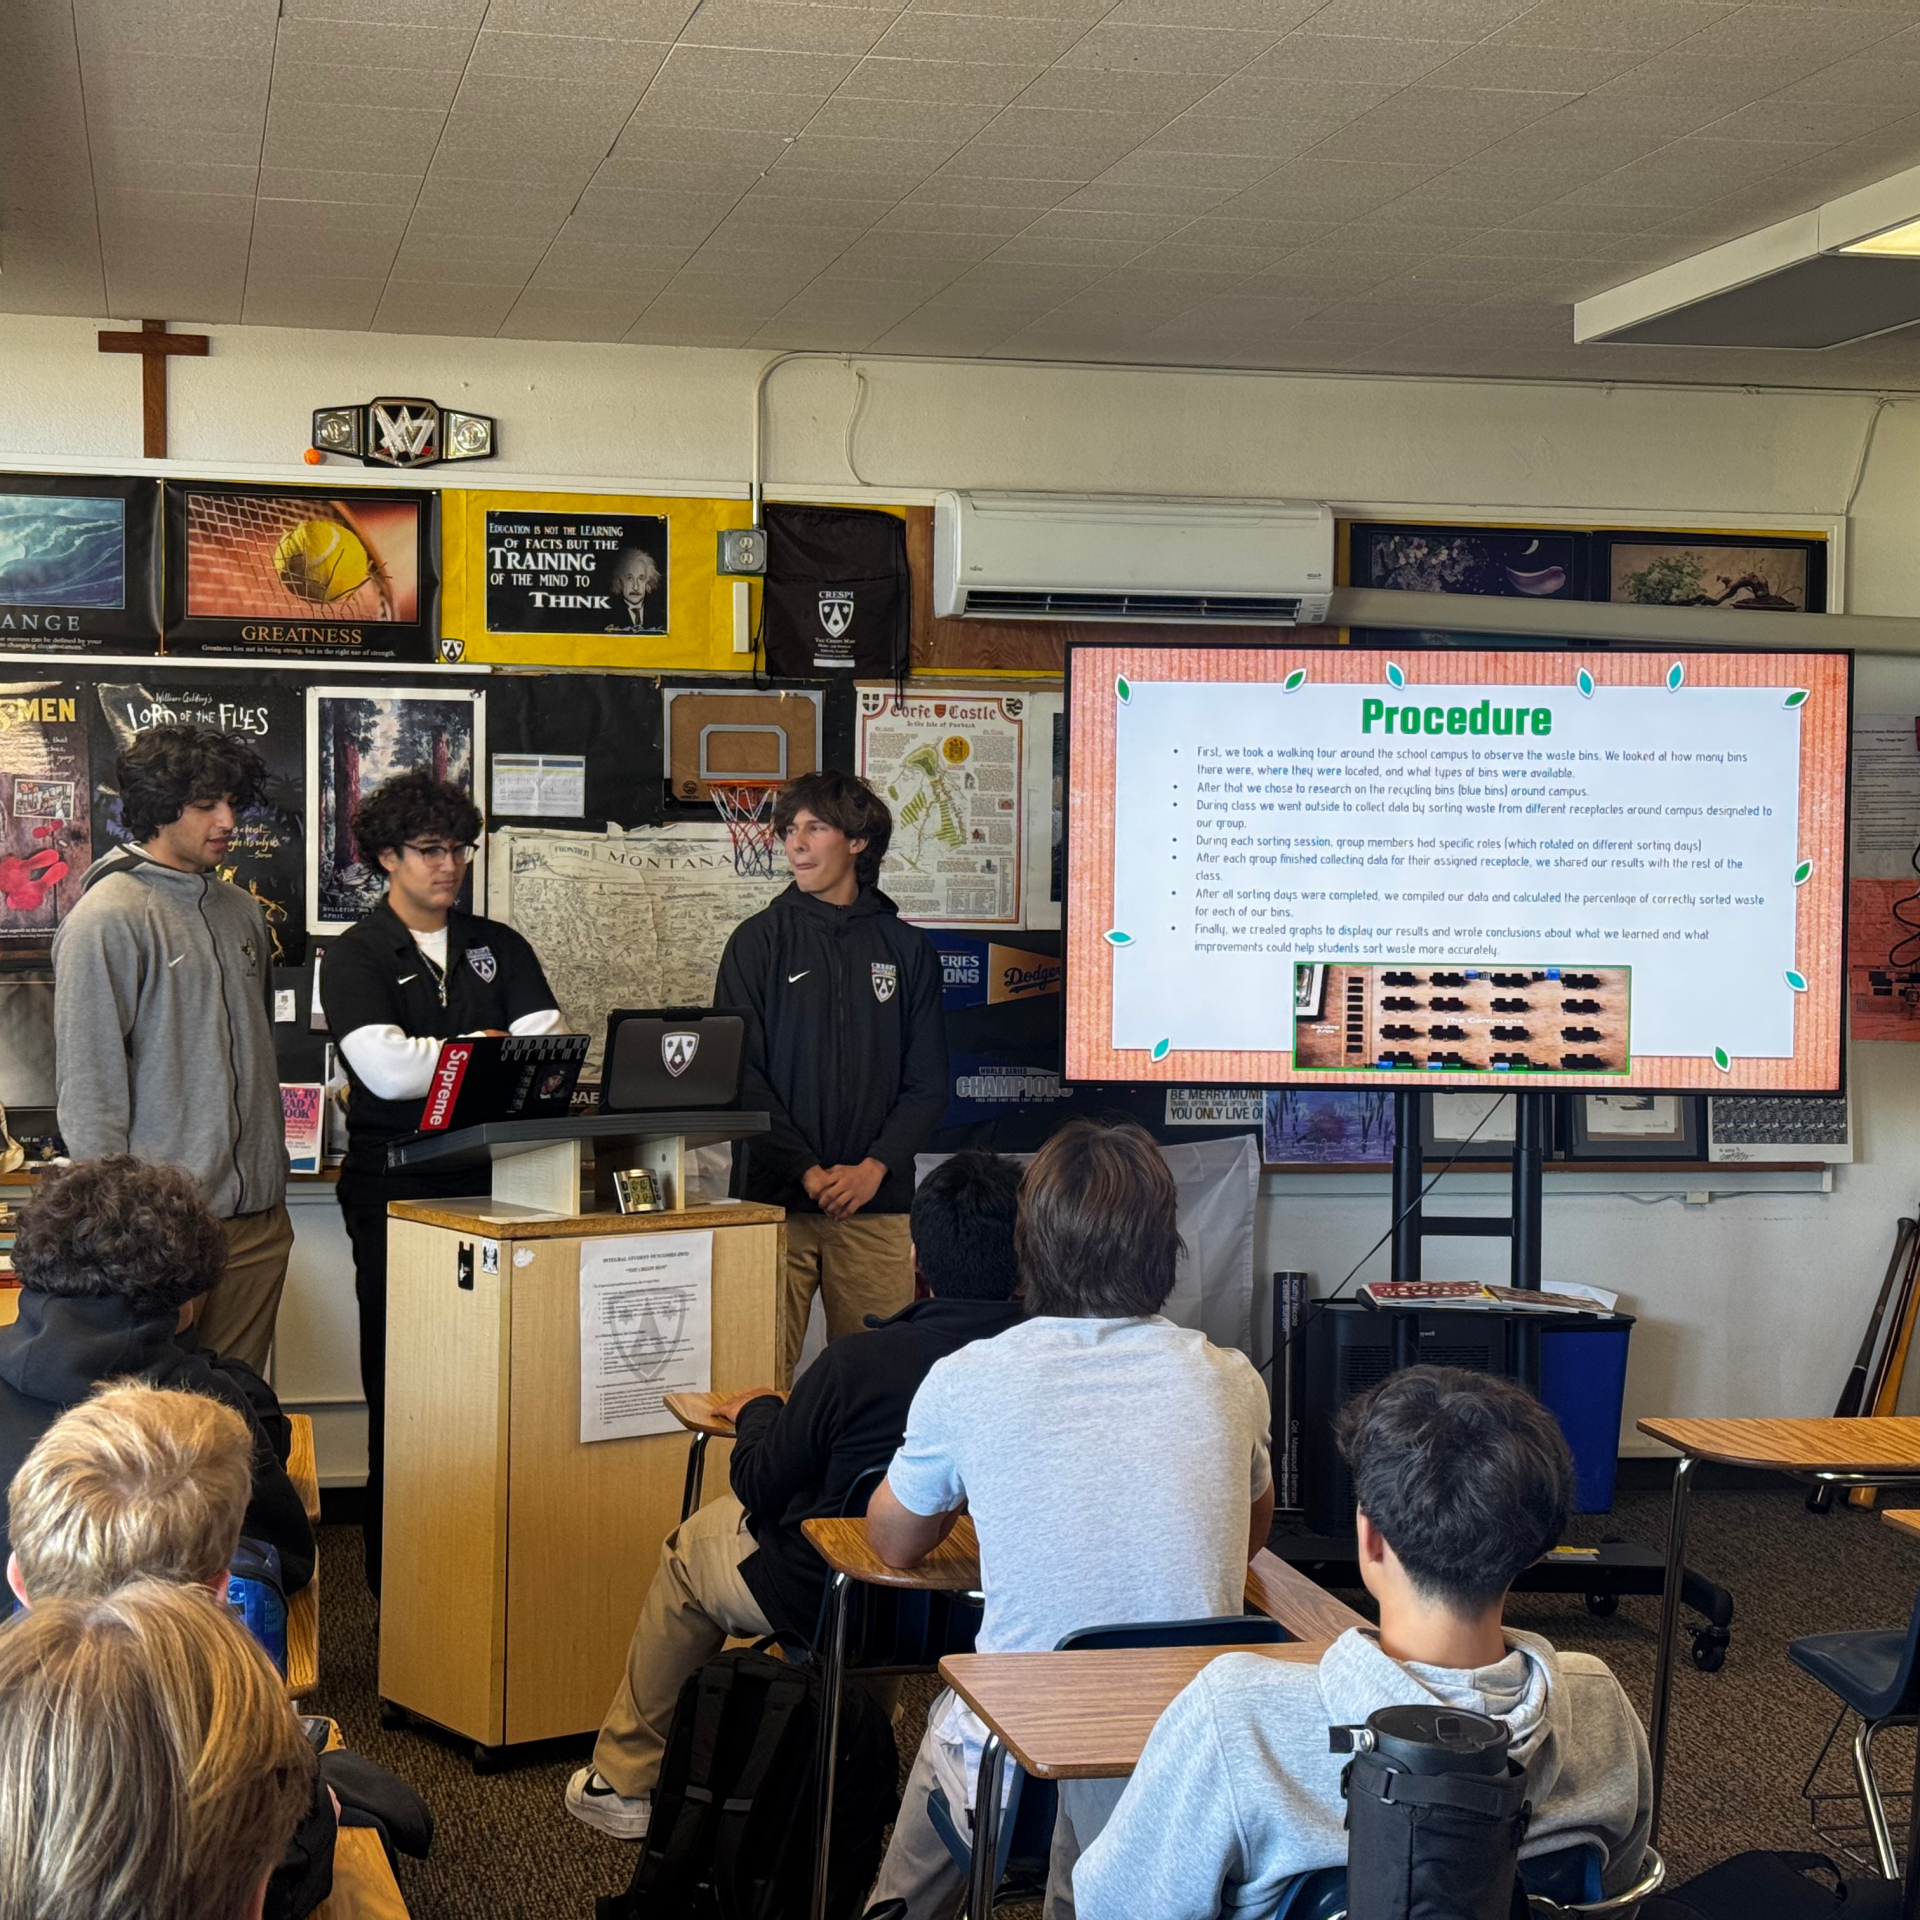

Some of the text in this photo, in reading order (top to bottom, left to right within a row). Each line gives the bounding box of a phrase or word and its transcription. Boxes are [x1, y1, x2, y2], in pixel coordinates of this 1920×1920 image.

[489, 523, 624, 537] EDUCATION IS NOT THE LEARNING
[504, 538, 619, 550] OF FACTS BUT THE
[489, 547, 596, 571] TRAINING
[490, 573, 590, 588] OF THE MIND TO
[528, 592, 612, 609] THINK
[818, 590, 854, 600] CRESPI
[0, 613, 81, 632] ANGE
[241, 625, 362, 644] GREATNESS
[17, 698, 76, 722] MEN
[890, 704, 996, 720] Corfe Castle
[1362, 699, 1553, 736] Procedure
[126, 703, 177, 734] LORD
[180, 710, 192, 723] OF
[218, 703, 269, 736] FLIES
[1197, 746, 1748, 764] First, we took a walking tour around the school campus to observe the waste bins. We looked at how many bins
[1197, 764, 1575, 779] there were, where they were located, and what types of bins were available.
[1196, 782, 1589, 799] After that we chose to research on the recycling bins (blue bins) around campus.
[1196, 800, 1773, 818] During class we went outside to collect data by sorting waste from different receptacles around campus designated to
[1196, 820, 1247, 831] our group.
[555, 846, 590, 857] FRONTIER
[608, 851, 734, 870] MONTANA
[940, 955, 980, 968] ERIES
[1003, 965, 1060, 991] Dodger
[1468, 1017, 1523, 1025] Commons
[500, 1037, 589, 1061] SUPREME
[980, 1067, 1028, 1075] WORLD SERIES
[281, 1089, 318, 1099] OW TO
[429, 1048, 468, 1127] Supreme
[1171, 1089, 1185, 1100] BE
[284, 1099, 316, 1109] EAD A
[285, 1109, 310, 1119] OOK
[1171, 1107, 1192, 1120] YOU
[1195, 1107, 1223, 1120] ONLY
[1225, 1107, 1250, 1120] LIVE
[1290, 1280, 1299, 1301] Kathy
